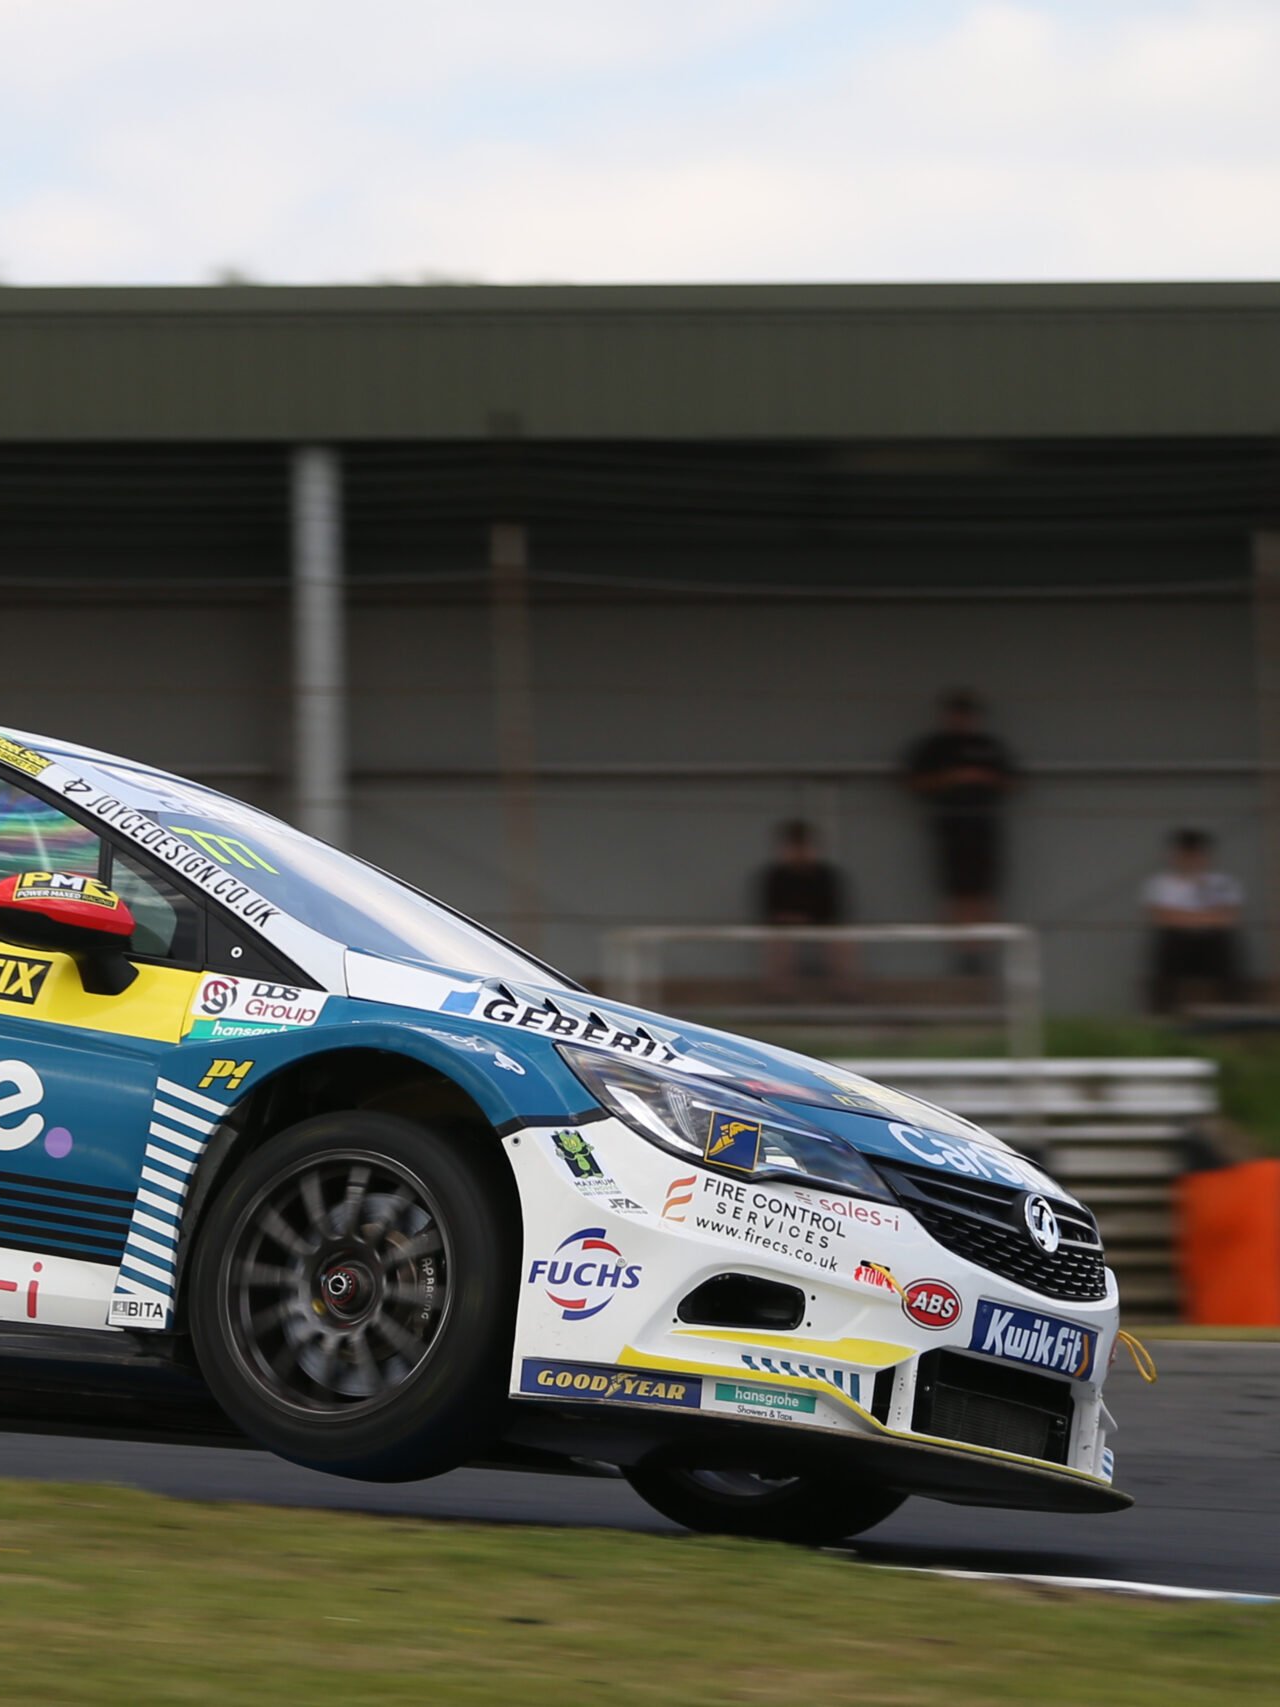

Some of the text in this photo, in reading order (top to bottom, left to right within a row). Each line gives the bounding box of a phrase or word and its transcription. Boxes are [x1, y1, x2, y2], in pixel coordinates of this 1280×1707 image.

[86, 795, 281, 927] JOYCEDESIGN.CO.UK
[167, 825, 281, 875] 777
[17, 889, 50, 899] POWER
[50, 890, 81, 900] MAXED
[252, 983, 301, 1001] DDS
[245, 998, 317, 1024] Group
[483, 999, 686, 1065] GEBERIT
[198, 1059, 255, 1090] P1
[888, 1122, 1058, 1196] CarS
[608, 1198, 643, 1209] JFA
[703, 1178, 847, 1239] FIRE CONTROL
[818, 1198, 900, 1232] sales-i
[715, 1201, 830, 1249] SERVICES
[695, 1216, 839, 1273] www.firecs.co.uk
[528, 1260, 643, 1289] FUCHS
[128, 1302, 163, 1318] BITA
[910, 1291, 956, 1319] ABS
[735, 1386, 800, 1407] hansgrohe
[736, 1405, 768, 1419] Showers
[777, 1409, 793, 1422] Taps
